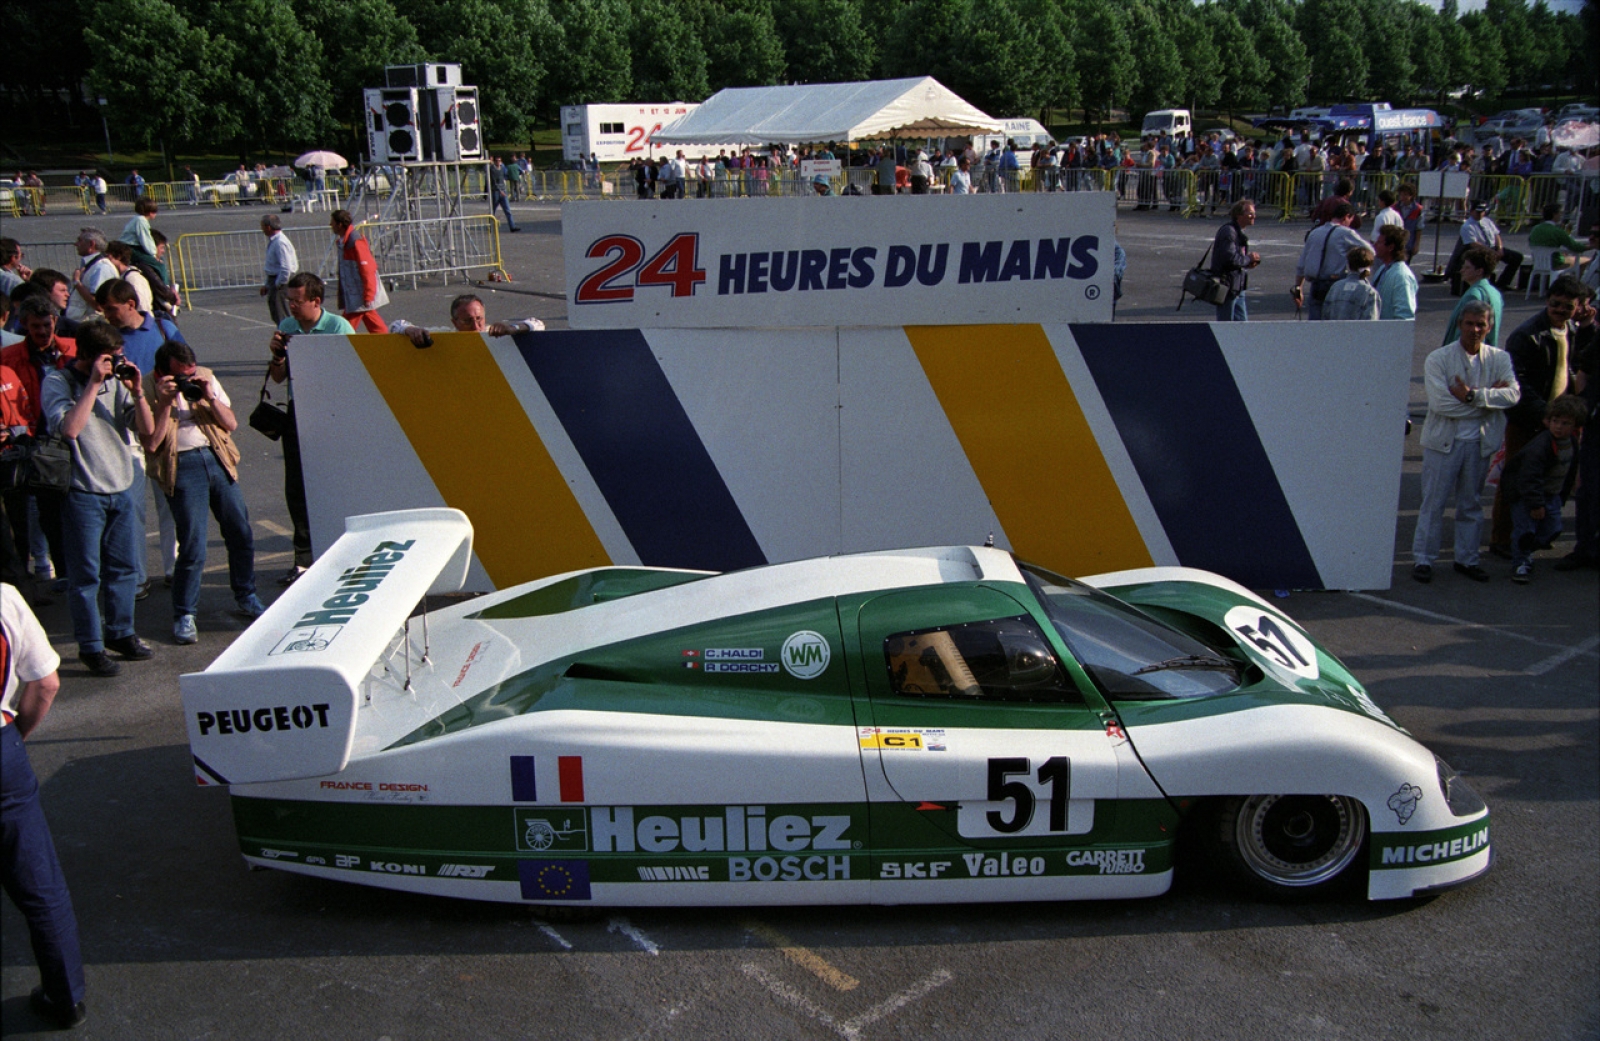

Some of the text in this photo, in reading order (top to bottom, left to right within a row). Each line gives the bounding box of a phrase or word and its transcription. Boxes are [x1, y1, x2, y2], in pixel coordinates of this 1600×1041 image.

[574, 232, 1100, 305] 24 HEURES DU MANS
[292, 539, 417, 629] Heuliez
[788, 642, 823, 668] WM
[1235, 615, 1311, 670] 51
[719, 664, 778, 672] DORCHY
[196, 703, 330, 736] PEUGEOT
[320, 780, 373, 791] FRANCE
[985, 755, 1071, 834] 51
[590, 805, 852, 852] Heuliez
[1065, 849, 1146, 867] GARRETT
[1381, 826, 1489, 865] MICHELIN
[369, 860, 426, 875] KONI
[728, 855, 851, 881] BOSCH
[879, 861, 952, 878] SKF
[962, 852, 1046, 877] Valeo
[1098, 861, 1145, 875] TURBO
